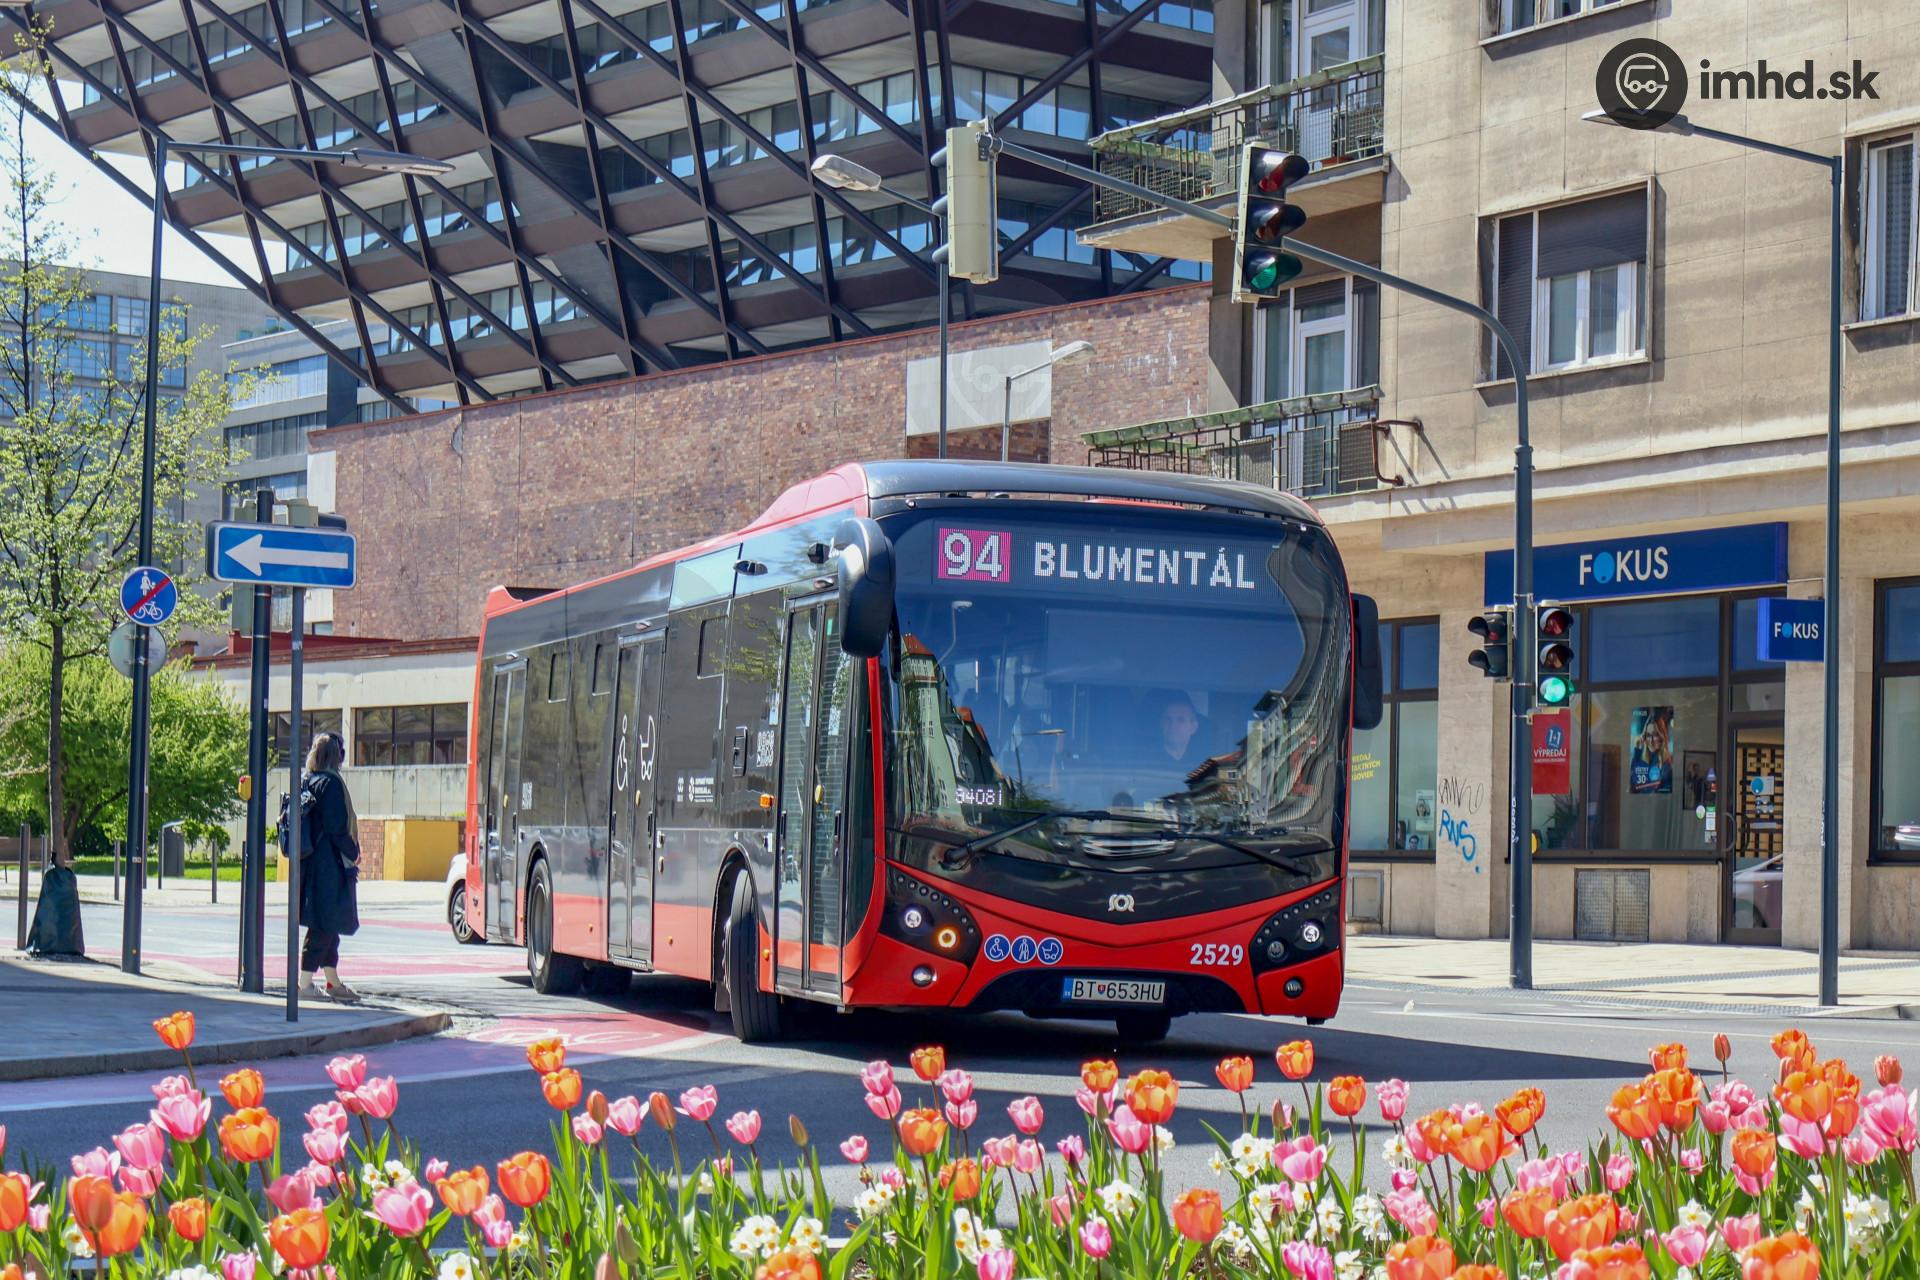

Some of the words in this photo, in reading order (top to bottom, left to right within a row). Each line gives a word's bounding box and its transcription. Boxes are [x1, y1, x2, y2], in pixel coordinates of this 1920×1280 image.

[943, 532, 1002, 578] 94
[1034, 541, 1255, 589] BLUMENTÁL
[1579, 546, 1669, 586] FOKUS
[1774, 622, 1819, 640] FOKUS
[1190, 943, 1244, 966] 2529
